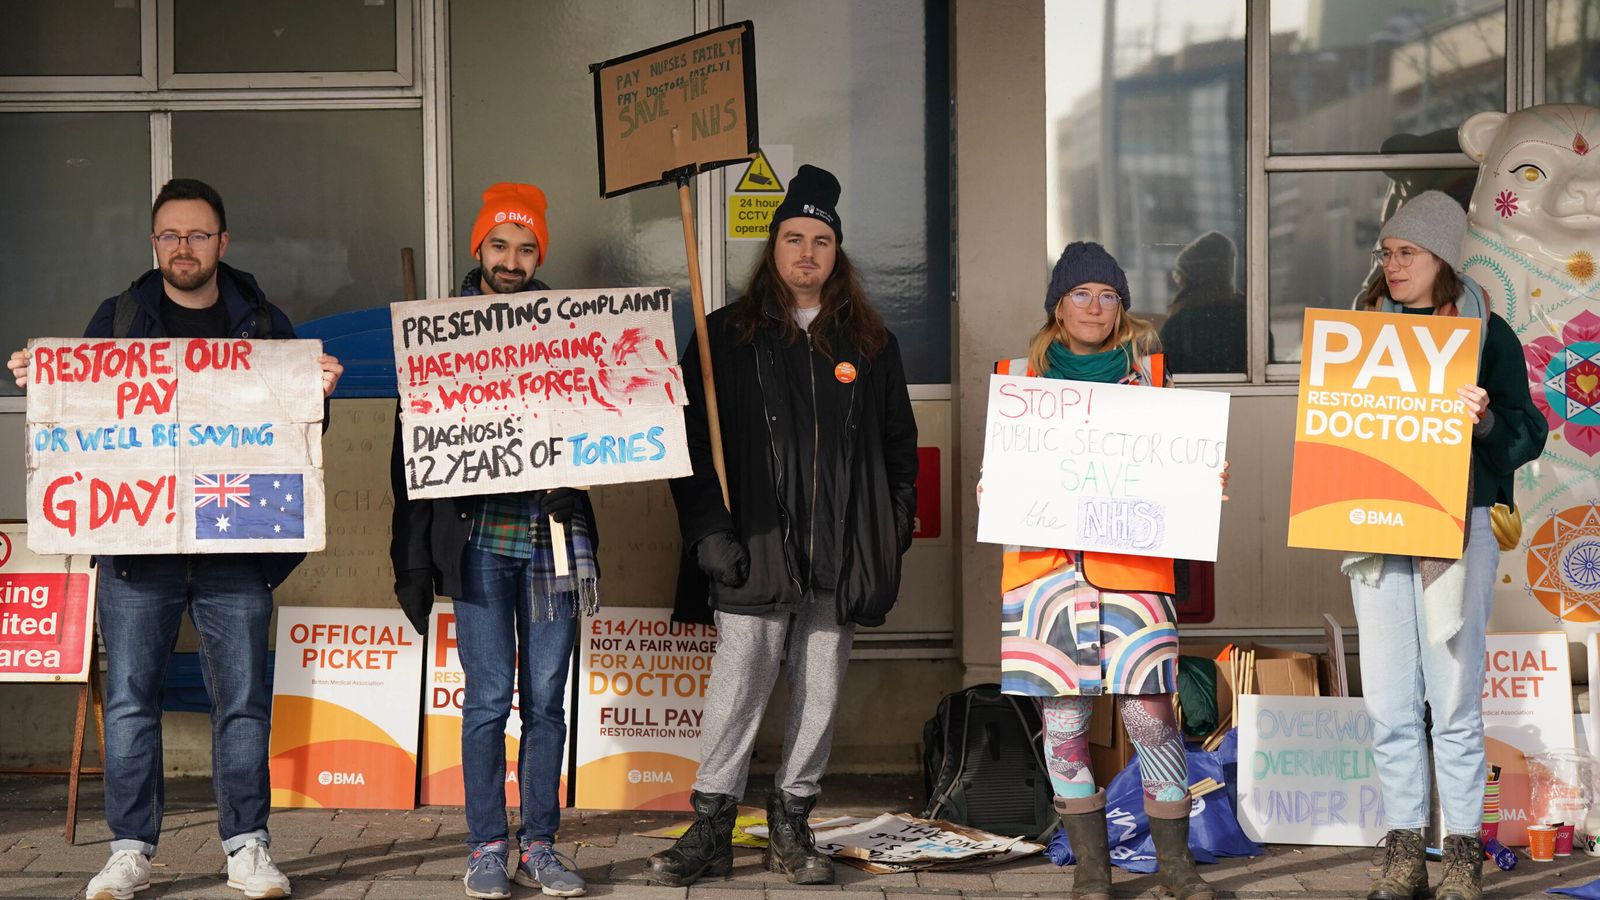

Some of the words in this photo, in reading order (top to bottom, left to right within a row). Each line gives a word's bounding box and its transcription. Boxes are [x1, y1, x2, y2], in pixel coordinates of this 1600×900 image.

[616, 69, 640, 90] PAY
[650, 53, 687, 77] NURSES
[692, 39, 740, 64] FAIRLY!
[617, 90, 638, 106] PAY
[689, 60, 730, 80] FAIRLY!
[618, 92, 669, 139] SAVE
[681, 75, 708, 102] THE
[691, 98, 737, 141] NHS
[738, 210, 768, 220] CCTV
[740, 198, 752, 208] 24
[756, 198, 780, 208] hour
[508, 212, 534, 226] BMA
[736, 224, 769, 235] operat
[402, 298, 551, 348] PRESENTING
[556, 288, 671, 320] COMPLAINT
[35, 340, 173, 385] RESTORE
[184, 338, 252, 373] OUR
[407, 331, 604, 382] HAEMORRHAGING
[1309, 319, 1471, 395] PAY
[116, 378, 178, 420] PAY
[998, 383, 1093, 424] STOP!
[1308, 390, 1427, 412] RESTORATION
[1430, 398, 1466, 415] FOR
[35, 426, 68, 453] OR
[152, 423, 180, 448] BE
[188, 423, 274, 448] SAYING
[413, 416, 523, 453] DIAGNOSIS:
[1305, 409, 1463, 445] DOCTORS
[406, 455, 442, 491] 12
[445, 438, 525, 485] YEARS
[530, 437, 564, 469] OF
[568, 426, 666, 466] TORIES
[992, 421, 1058, 454] PUBLIC
[1070, 428, 1164, 467] SECTOR
[1170, 436, 1225, 469] CUTS
[1060, 458, 1142, 498] SAVE
[42, 471, 177, 537] G'DAY!
[335, 490, 394, 512] CHA
[1022, 500, 1068, 530] the
[1084, 501, 1160, 550] NHS
[1368, 511, 1404, 526] BMA
[2, 612, 57, 636] ited
[290, 624, 412, 646] OFFICIAL
[592, 619, 696, 638] £14/HOUR
[302, 648, 398, 670] PICKET
[590, 638, 622, 651] NOT
[625, 640, 636, 651] A
[640, 640, 672, 652] FAIR
[676, 640, 717, 653] WAGE
[590, 654, 627, 670] FOR
[632, 655, 646, 670] A
[1485, 650, 1558, 672] ICIAL
[1482, 676, 1544, 698] KET
[600, 708, 658, 726] FULL
[665, 709, 703, 727] PAY
[1256, 708, 1375, 744] OVERWO
[600, 728, 676, 738] RESTORATION
[334, 772, 365, 785] BMA
[642, 770, 674, 784] BMA
[1252, 786, 1348, 827] UNDER
[1358, 785, 1386, 829] PA
[900, 825, 948, 841] THE
[945, 839, 1003, 851] ONLY
